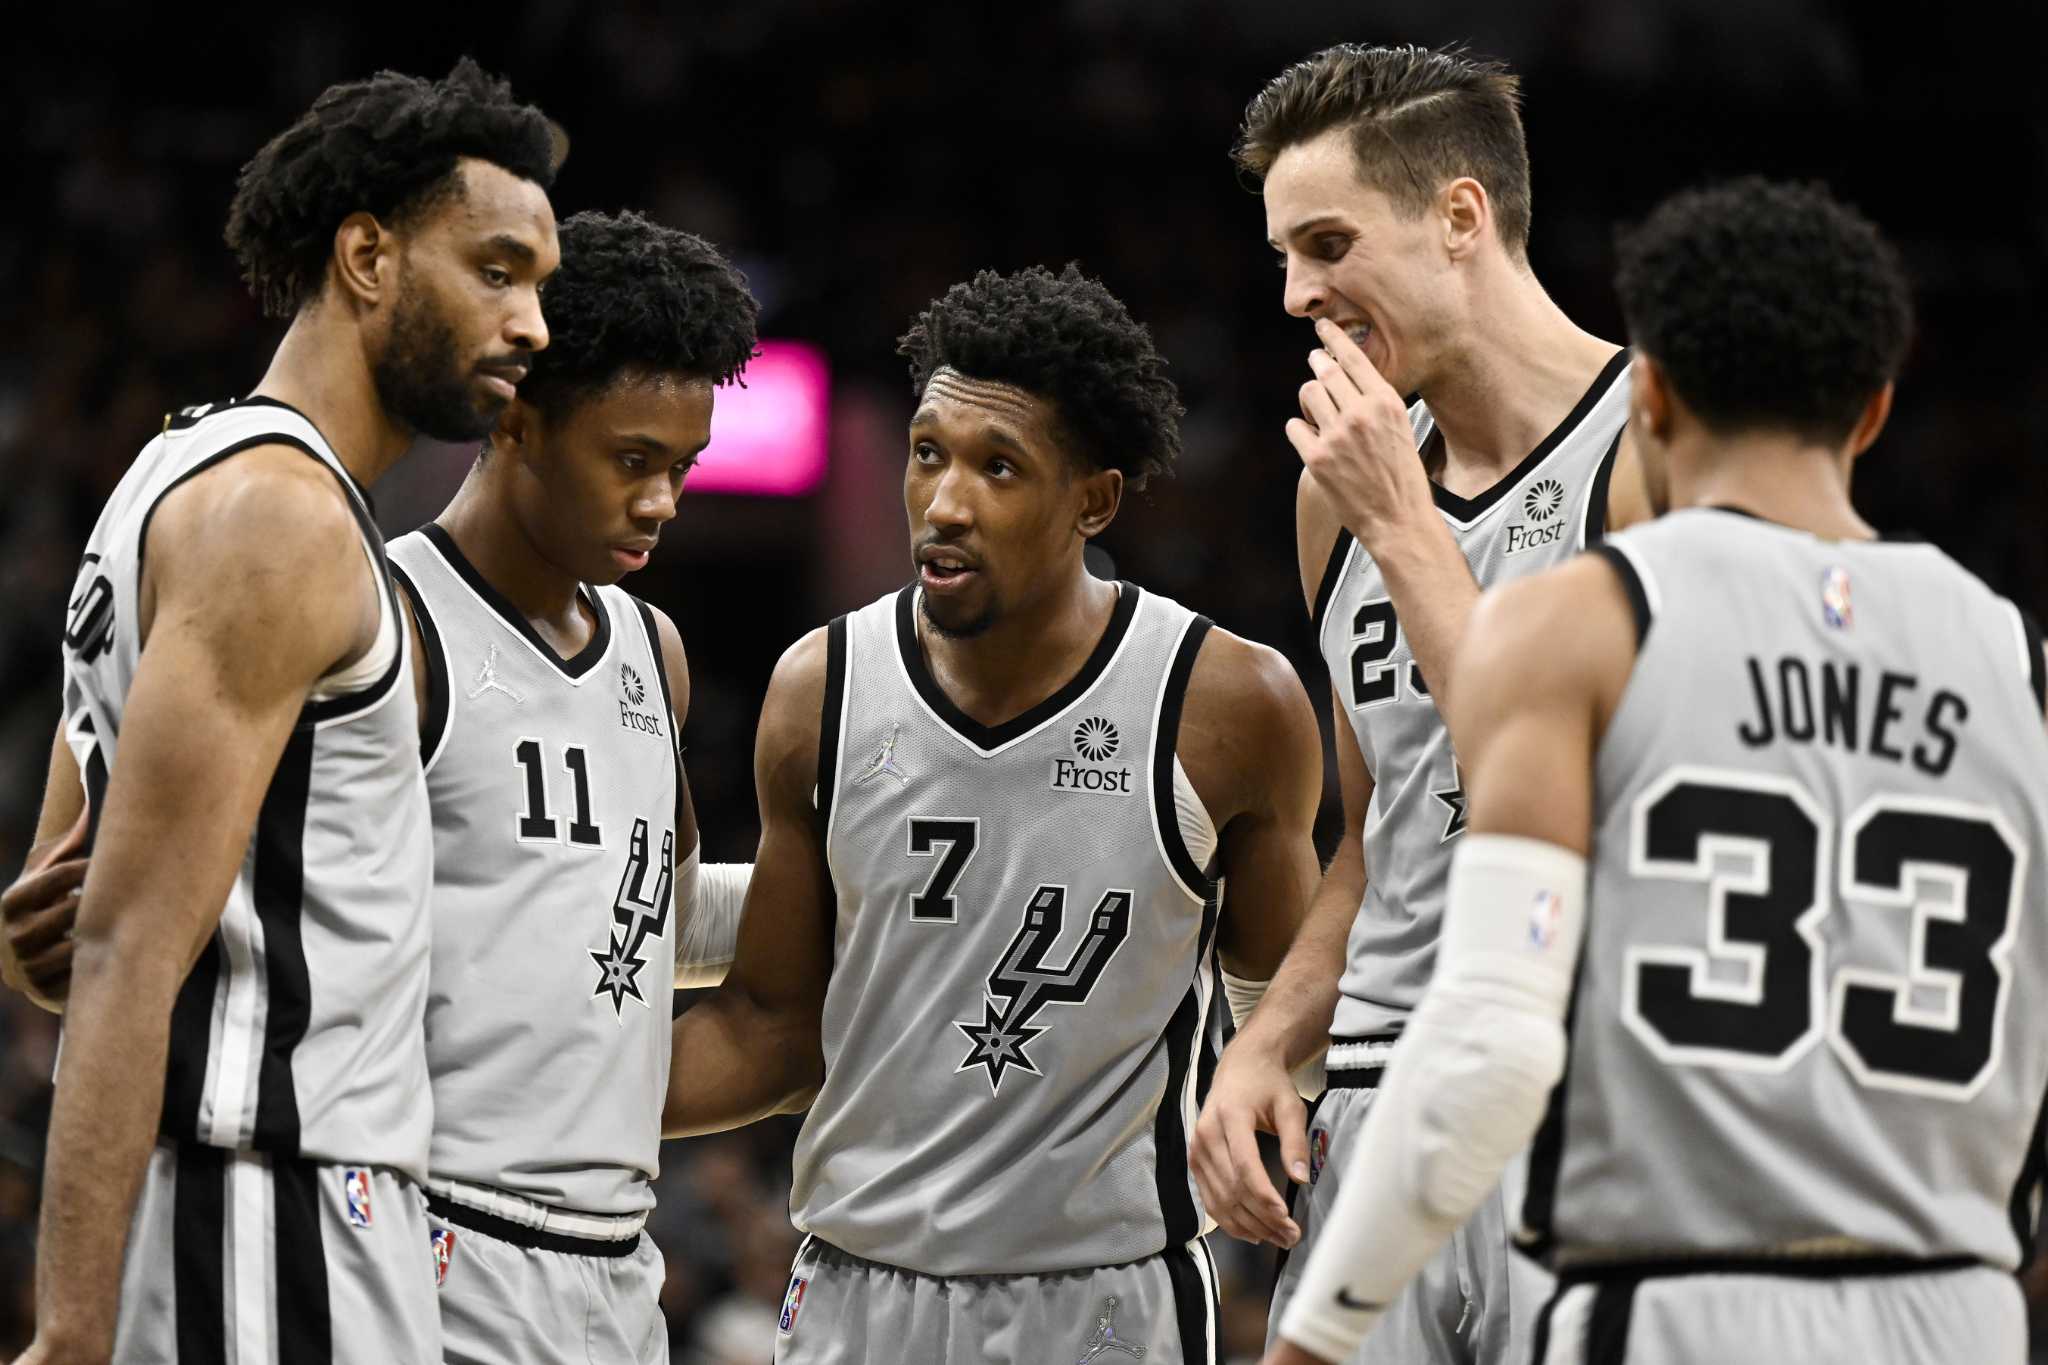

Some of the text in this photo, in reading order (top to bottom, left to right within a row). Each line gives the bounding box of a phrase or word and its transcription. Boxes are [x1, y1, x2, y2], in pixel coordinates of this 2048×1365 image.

[1505, 518, 1566, 553] Frost
[619, 700, 664, 737] Frost
[1738, 656, 1970, 778] JONES
[514, 738, 605, 849] 11
[1053, 759, 1131, 793] Frost
[908, 817, 980, 923] 7
[1621, 765, 2027, 1101] 33
